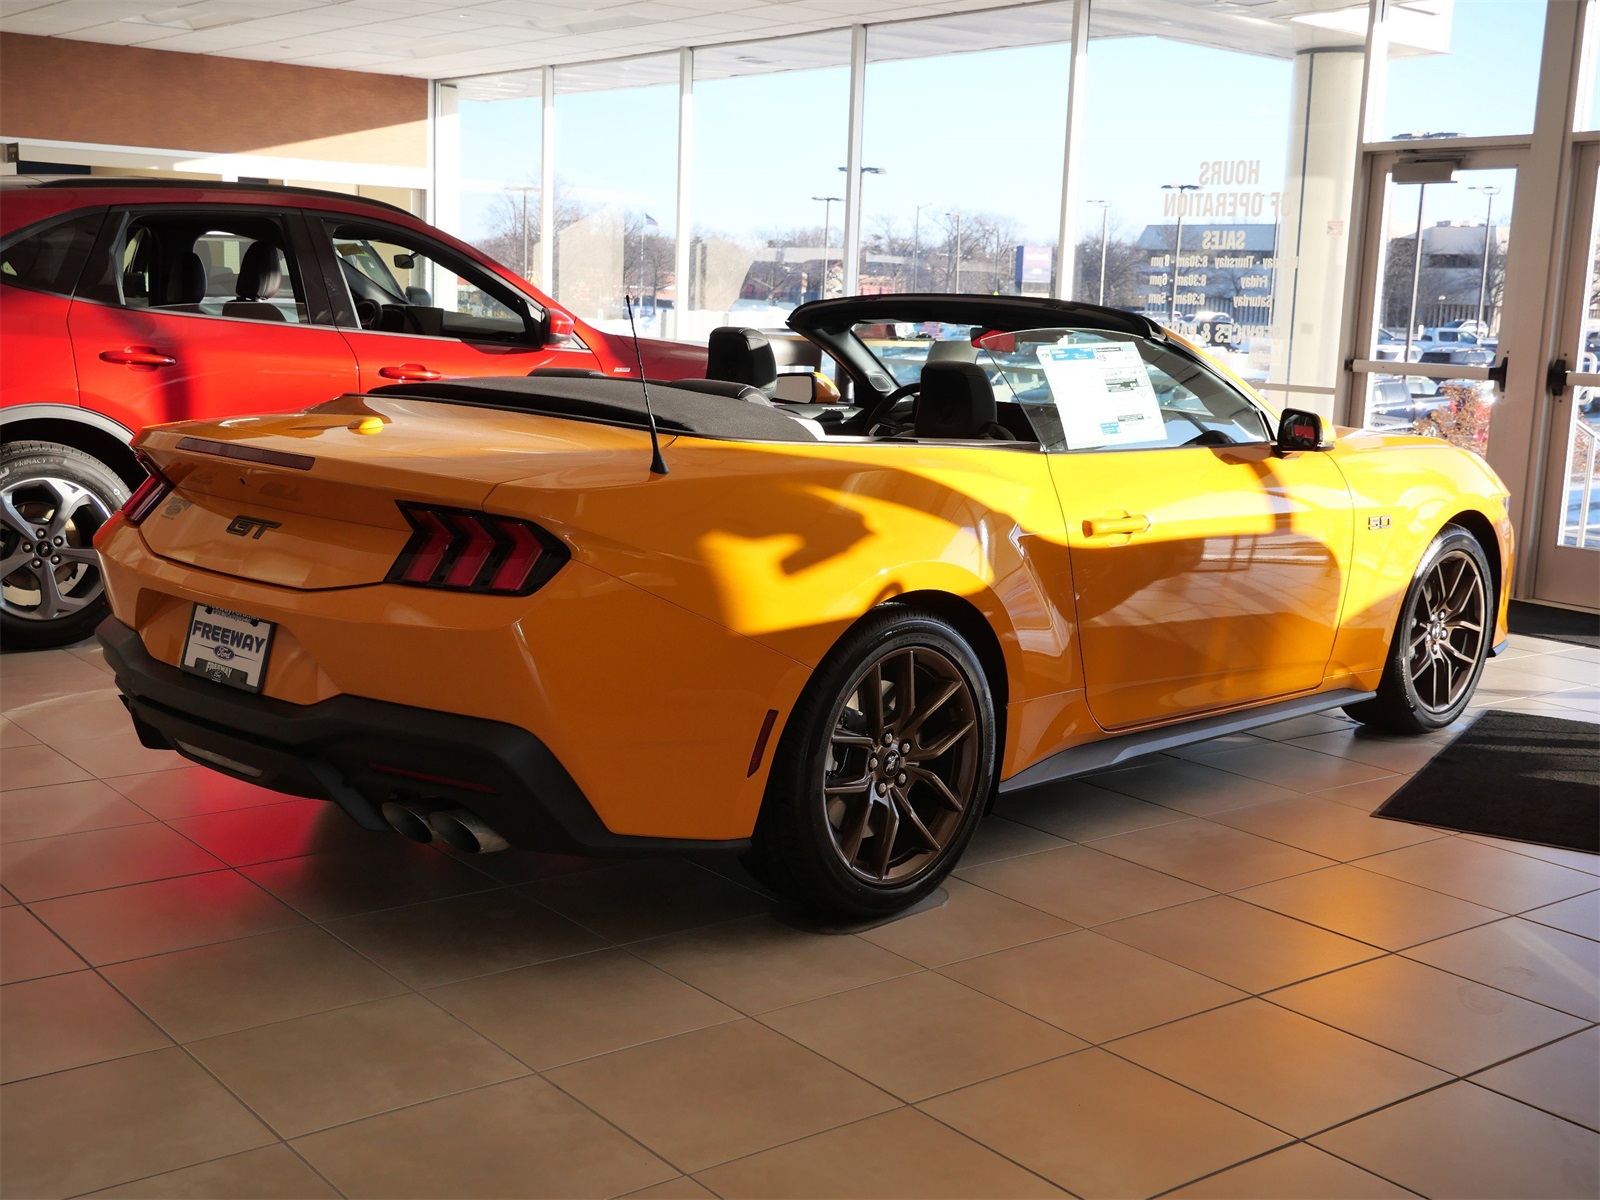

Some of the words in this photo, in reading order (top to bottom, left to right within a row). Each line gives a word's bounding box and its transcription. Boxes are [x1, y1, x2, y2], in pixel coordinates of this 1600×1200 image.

[14, 457, 47, 468] PRIMACY
[226, 515, 282, 540] GT
[192, 620, 266, 653] FREEWAY
